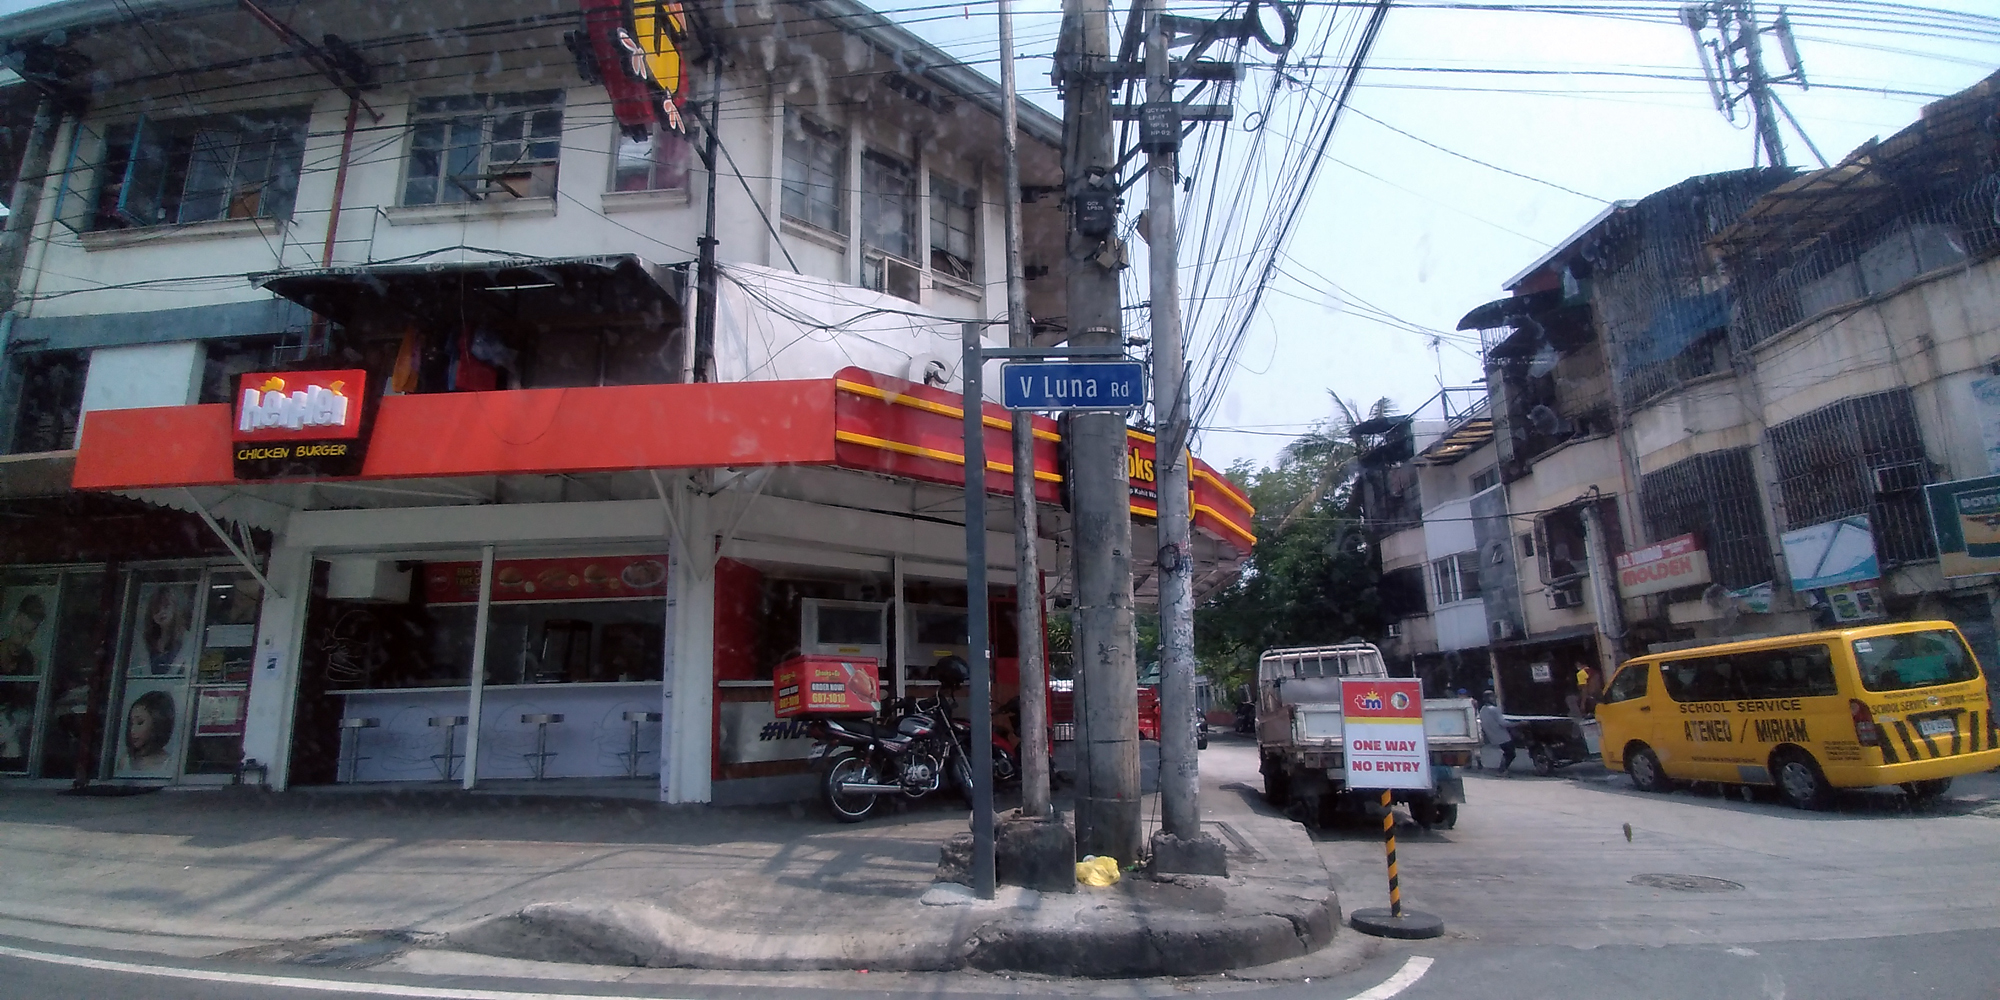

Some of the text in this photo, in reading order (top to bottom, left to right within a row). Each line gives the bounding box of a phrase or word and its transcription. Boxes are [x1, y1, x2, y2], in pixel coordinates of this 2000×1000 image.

[1020, 376, 1129, 398] V Luna Rd
[238, 444, 347, 461] CHICKEN BURGER
[812, 683, 829, 692] ORDER
[1679, 699, 1802, 714] SCHOOL SERVICE
[1684, 718, 1733, 743] ATENEO
[1754, 717, 1811, 743] MIRIAM
[1352, 739, 1417, 752] ONE WAY
[1352, 760, 1421, 773] NO ENTRY
